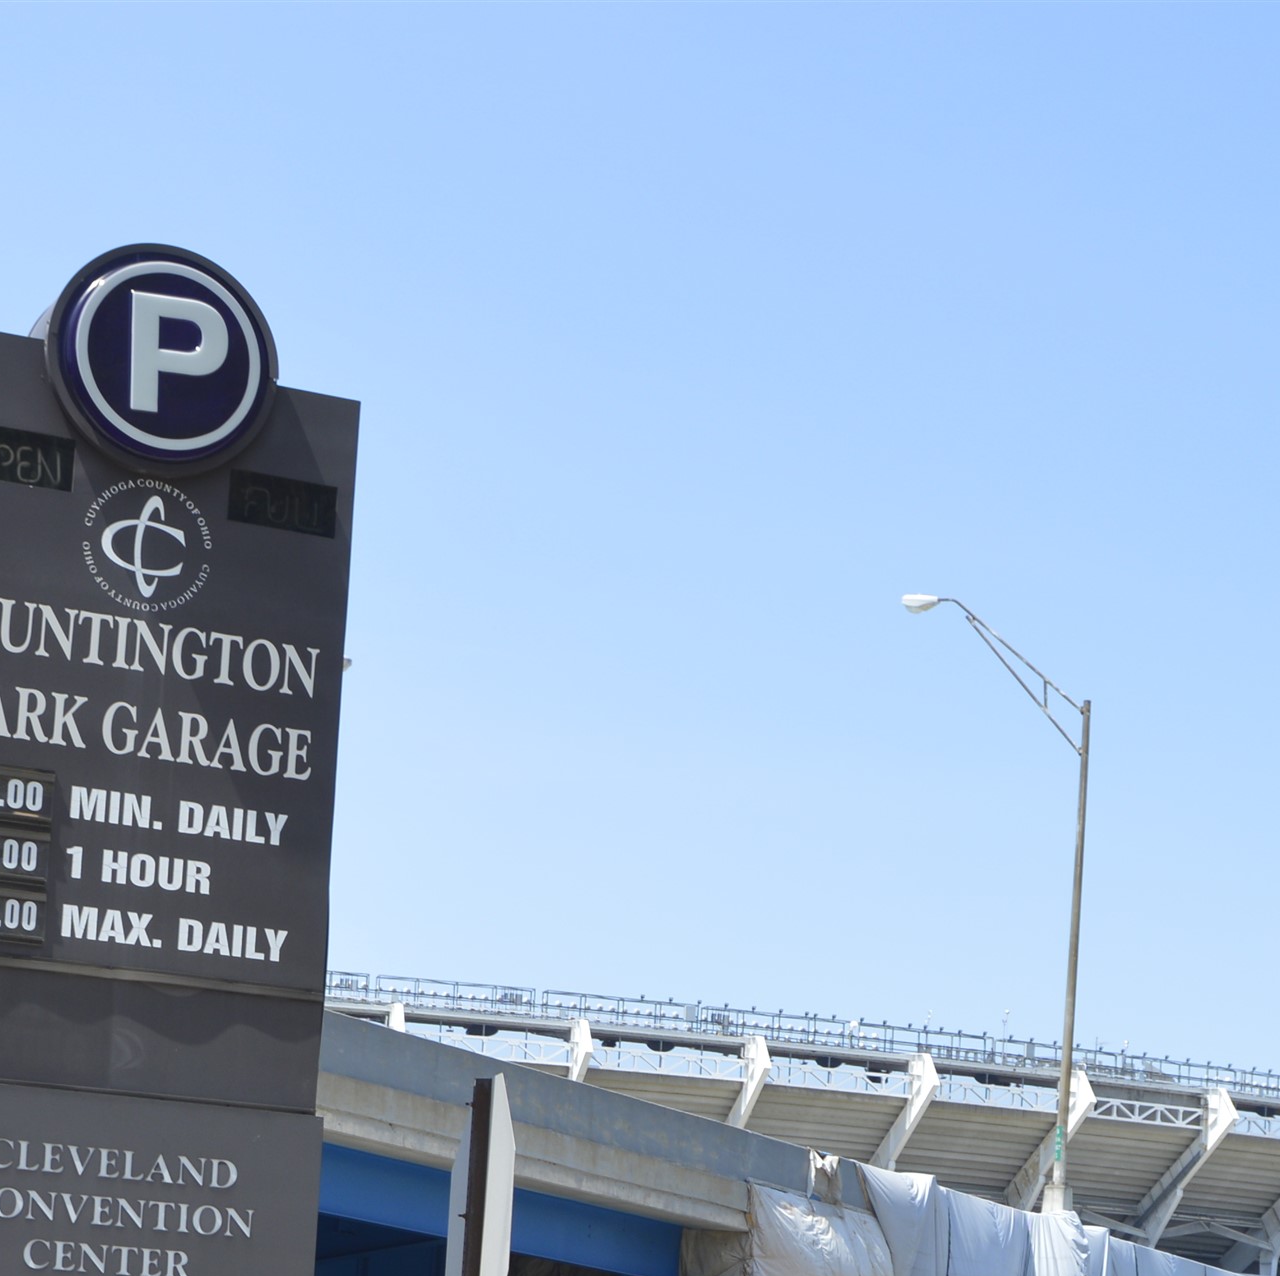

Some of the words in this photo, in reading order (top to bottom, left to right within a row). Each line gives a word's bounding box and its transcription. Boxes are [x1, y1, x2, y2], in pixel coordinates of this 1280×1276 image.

[130, 290, 229, 413] P
[83, 479, 136, 528] CUYAHOGA
[136, 477, 188, 503] COUNTY
[185, 500, 201, 516] OF
[196, 517, 213, 550] OHIO
[82, 540, 99, 575] OHIO
[93, 575, 110, 592] OF
[107, 589, 160, 613] COUNTY
[160, 563, 211, 611] CUYAHOGA
[101, 701, 313, 782] GARAGE
[69, 785, 164, 832] MIN.
[178, 800, 289, 847] DAILY
[65, 846, 83, 879] 1
[101, 849, 211, 896] HOUR
[60, 905, 163, 949] MAX.
[177, 918, 289, 963] DAILY
